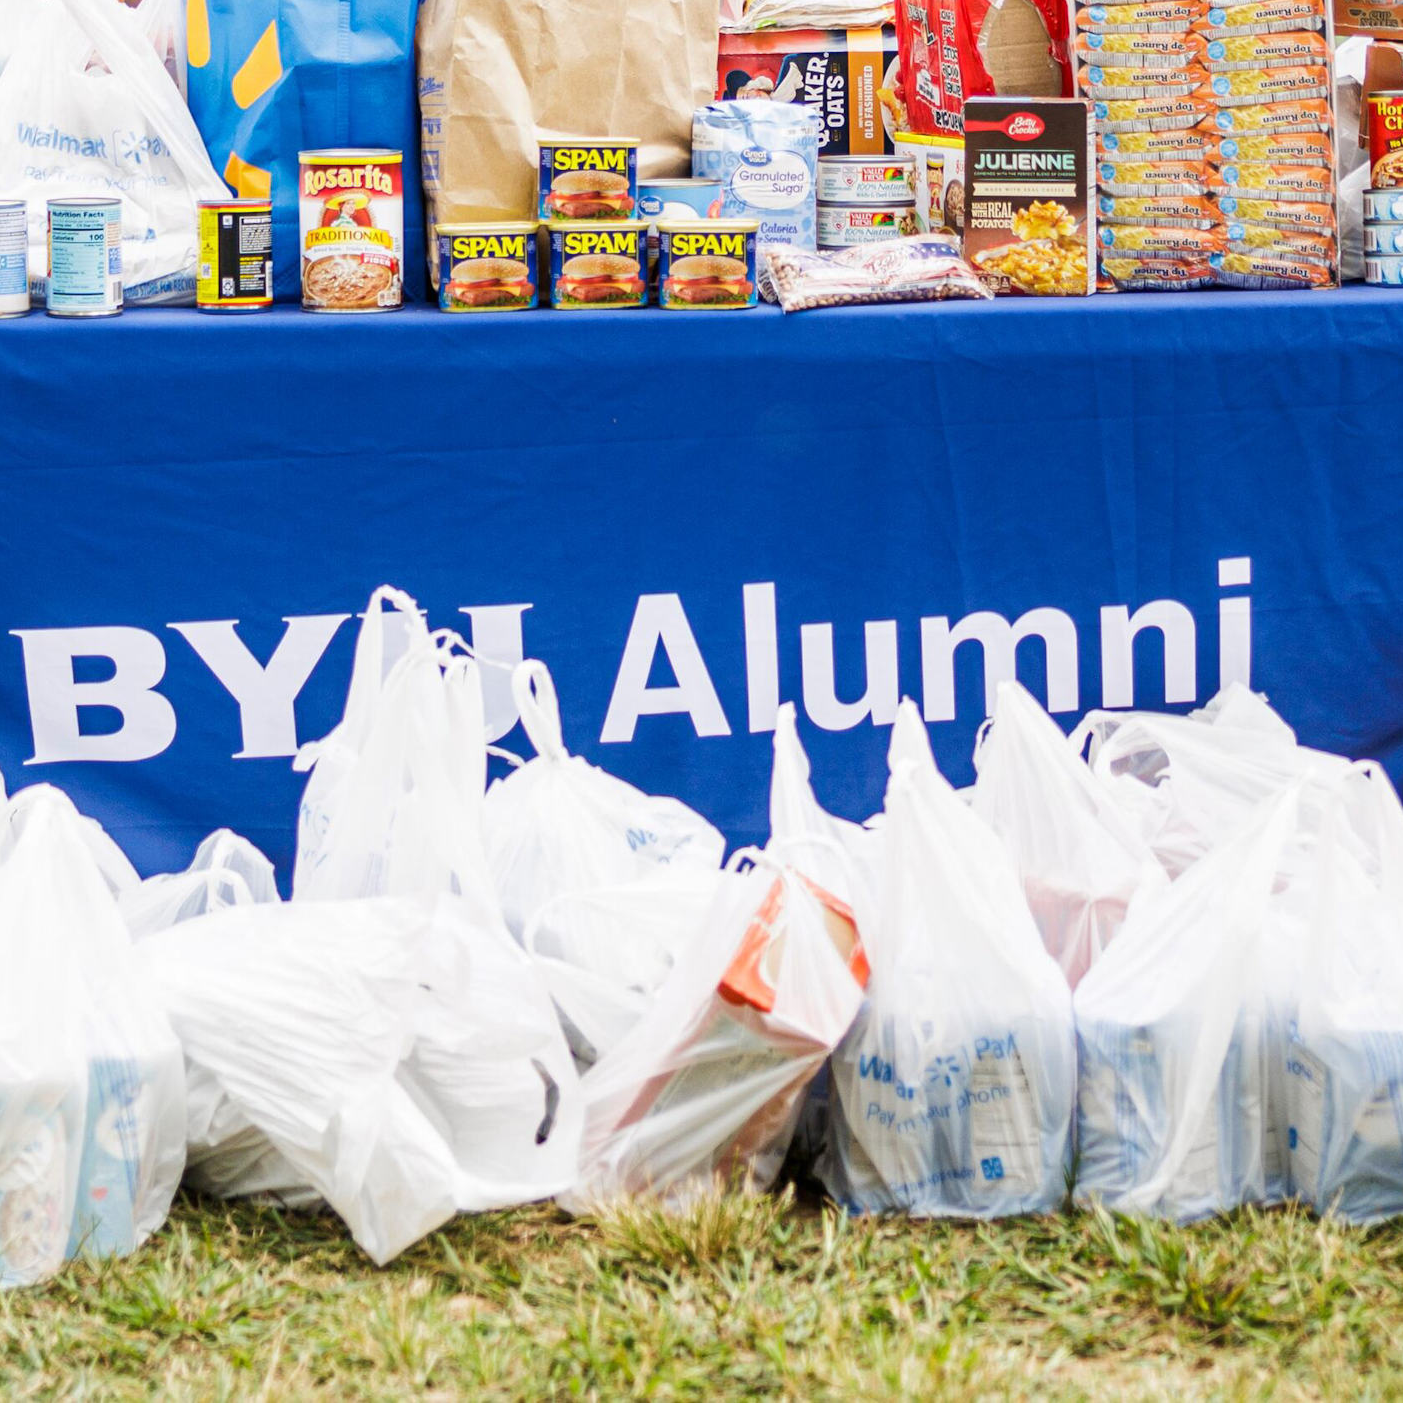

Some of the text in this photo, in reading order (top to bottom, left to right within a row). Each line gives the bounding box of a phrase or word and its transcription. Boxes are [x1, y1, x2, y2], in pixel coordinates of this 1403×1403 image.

[1136, 8, 1191, 18] Top Ramen
[1255, 5, 1312, 18] Top Ramen
[1255, 46, 1312, 55] Top Ramen
[1133, 72, 1189, 81] Top Ramen
[1260, 76, 1317, 88] Top Ramen
[827, 76, 845, 127] OATS
[863, 65, 873, 139] OLD FASHIONED
[1137, 103, 1194, 113] Top Ramen
[1014, 116, 1037, 127] Betty
[1262, 112, 1318, 123] Top Ramen
[1008, 124, 1041, 135] Crocker
[18, 122, 106, 159] Walmart
[1148, 136, 1204, 147] Top Ramen
[1390, 139, 1403, 148] No
[743, 150, 767, 159] Great
[1268, 146, 1324, 155] Top Ramen
[554, 149, 626, 171] SPAM
[974, 154, 1075, 170] JULIENNE
[304, 165, 392, 196] Rosarita
[739, 172, 805, 182] Granulated
[1145, 171, 1200, 180] Top Ramen
[772, 183, 804, 195] Sugar
[1268, 179, 1324, 189] Top Ramen
[988, 202, 1012, 218] REAL
[760, 222, 798, 234] Calories
[310, 230, 383, 243] TRADITIONAL
[453, 236, 525, 258] SPAM
[565, 233, 637, 255] SPAM
[672, 233, 744, 255] SPAM
[600, 557, 1252, 745] Alumni
